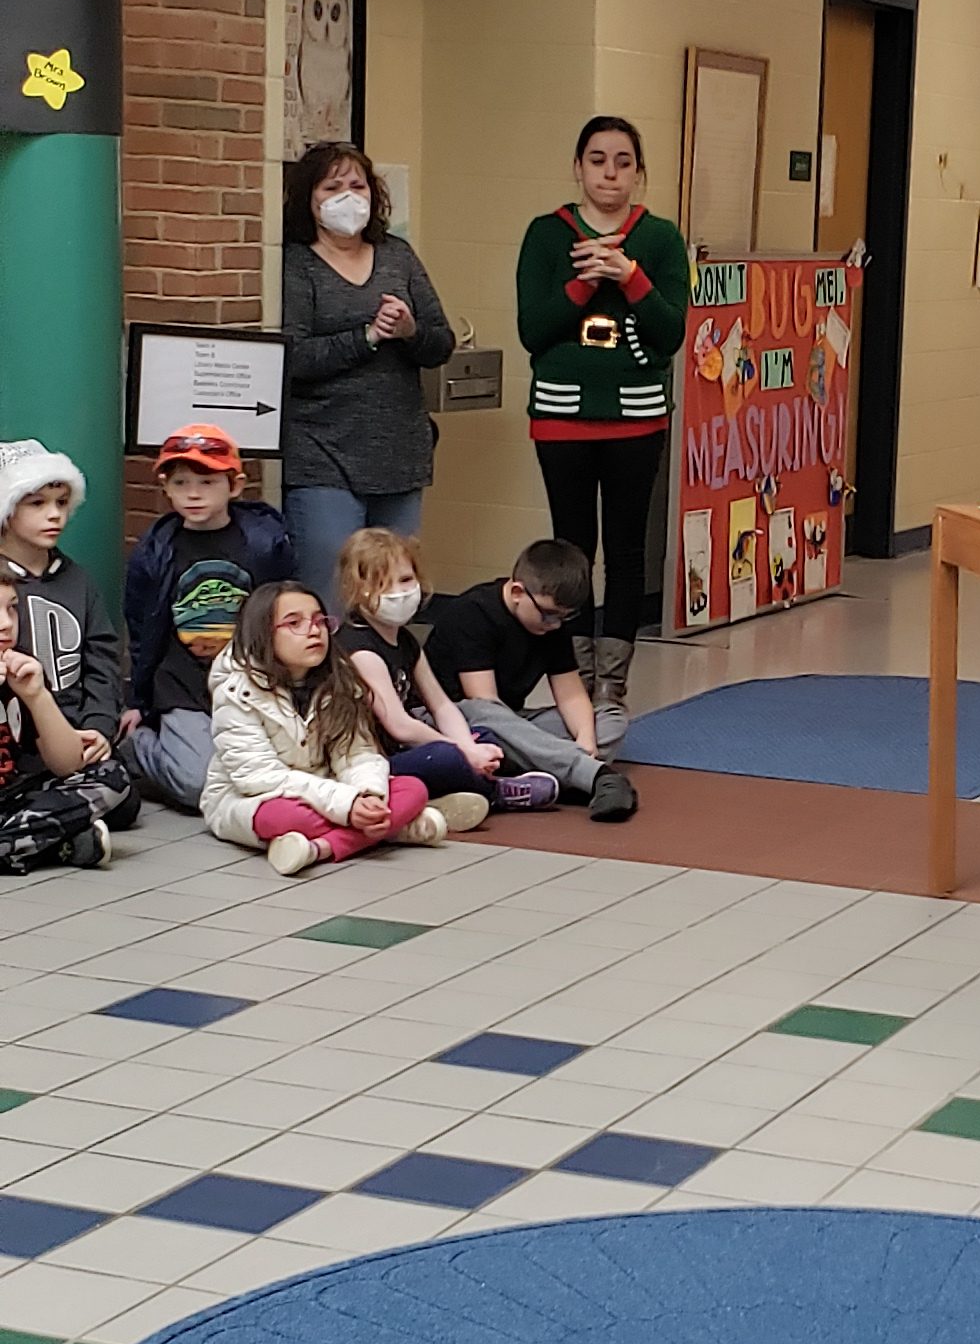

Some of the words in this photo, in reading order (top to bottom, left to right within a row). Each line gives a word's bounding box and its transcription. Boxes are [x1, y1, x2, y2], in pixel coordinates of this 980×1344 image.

[751, 262, 812, 340] BUG
[764, 351, 794, 388] I'M
[687, 393, 844, 490] MEASURING!
